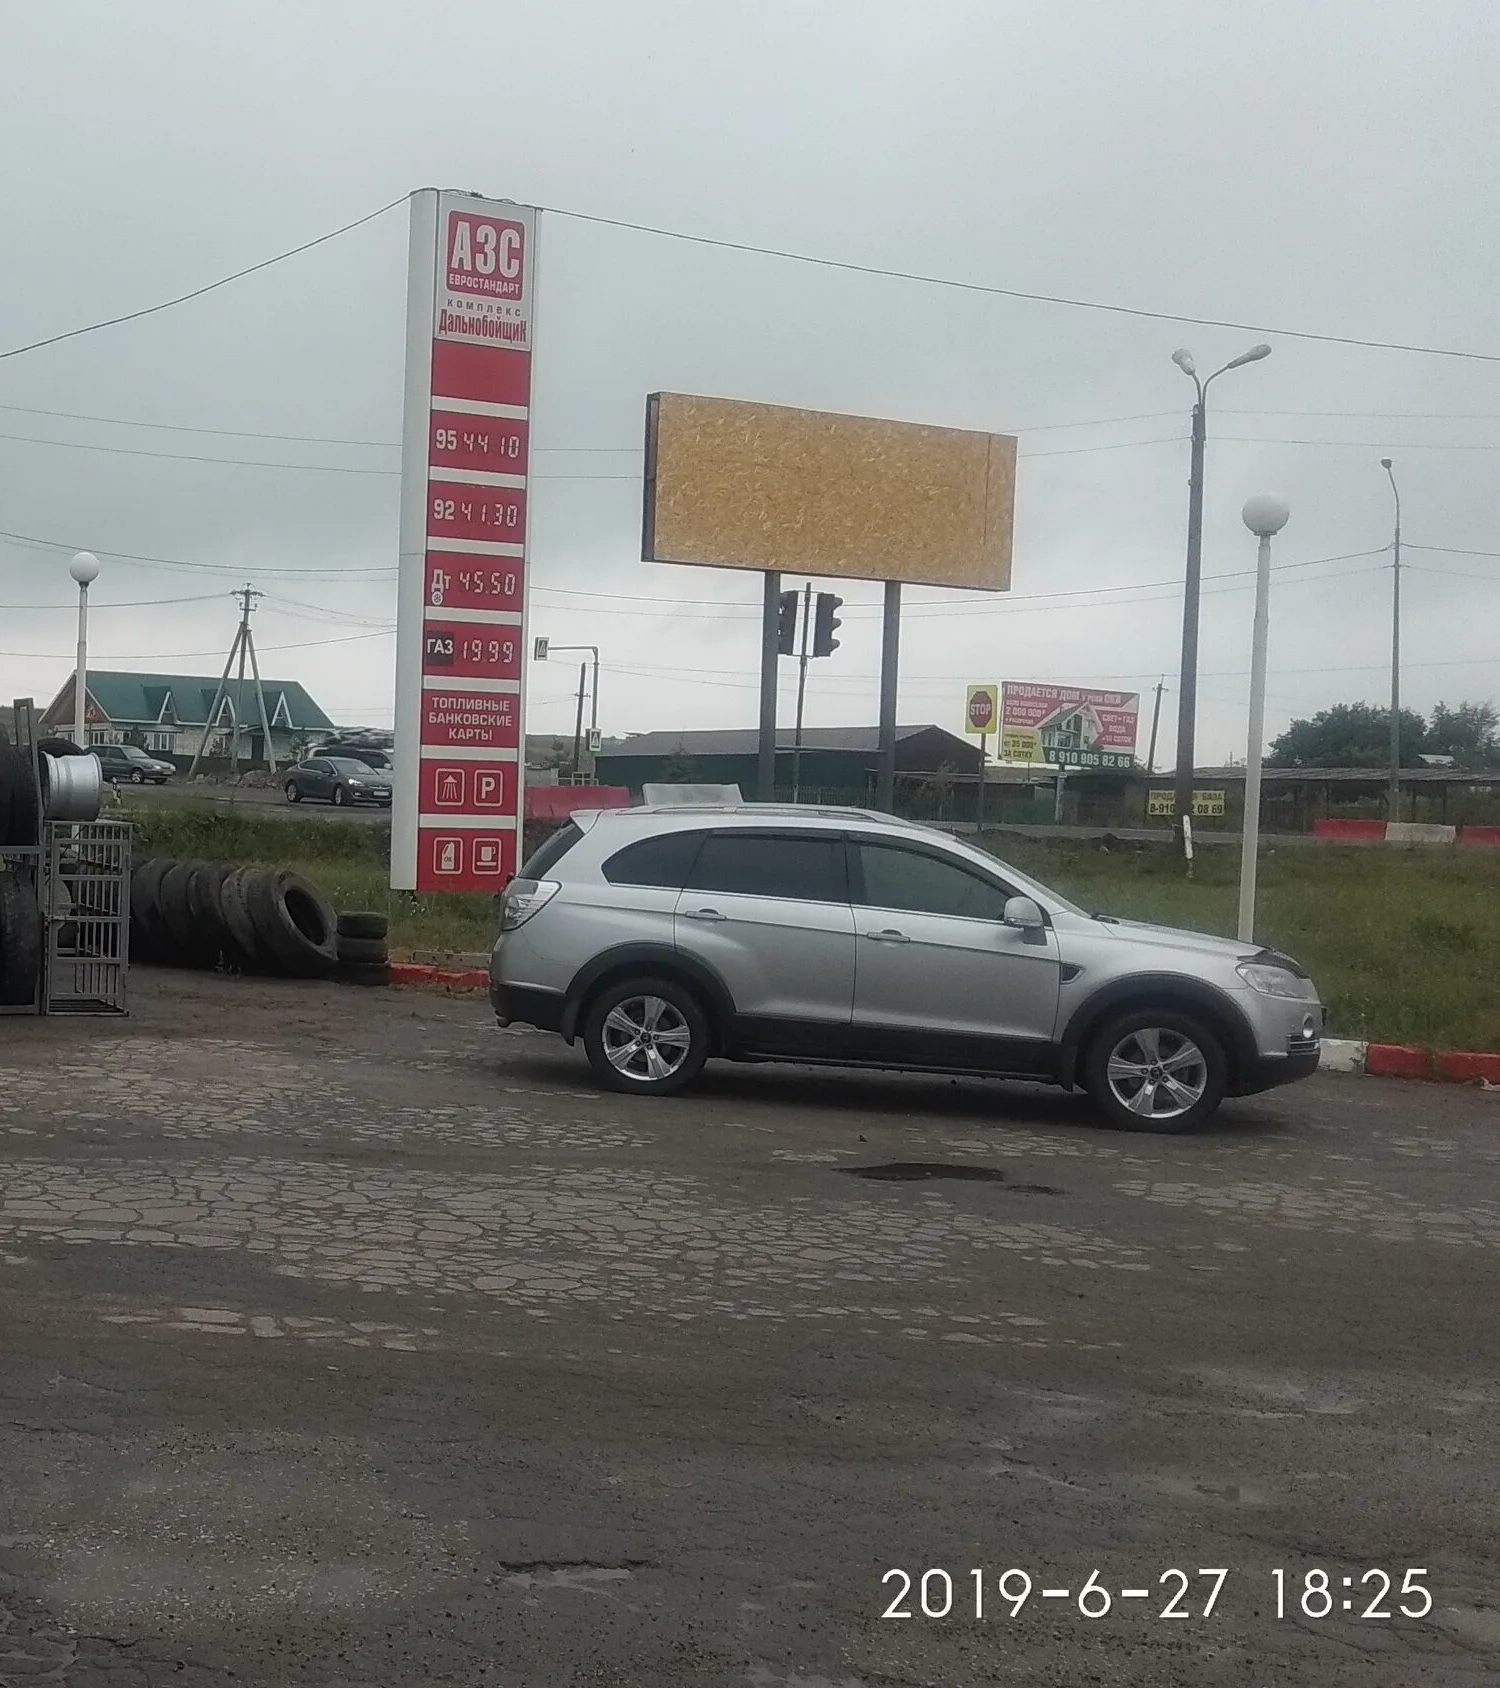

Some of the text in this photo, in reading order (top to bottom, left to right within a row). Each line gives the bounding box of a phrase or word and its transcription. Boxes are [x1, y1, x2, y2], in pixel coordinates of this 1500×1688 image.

[450, 220, 521, 279] АЗС
[449, 274, 520, 295] ЕВРОСТАНДАРТ
[447, 298, 521, 317] комплекс
[435, 429, 457, 451] 95
[433, 499, 455, 522] 92
[426, 638, 454, 655] ГАЗ
[1007, 685, 1057, 699] ПРОДАЕТСЯ
[1060, 690, 1080, 701] ДОМ
[431, 697, 510, 712] ТОПЛИВНЫЕ
[970, 703, 991, 716] STOP
[429, 712, 512, 727] БАНКОВСКИЕ
[449, 727, 493, 741] КАРТЫ
[1059, 752, 1077, 764] 910
[1102, 755, 1114, 767] 82
